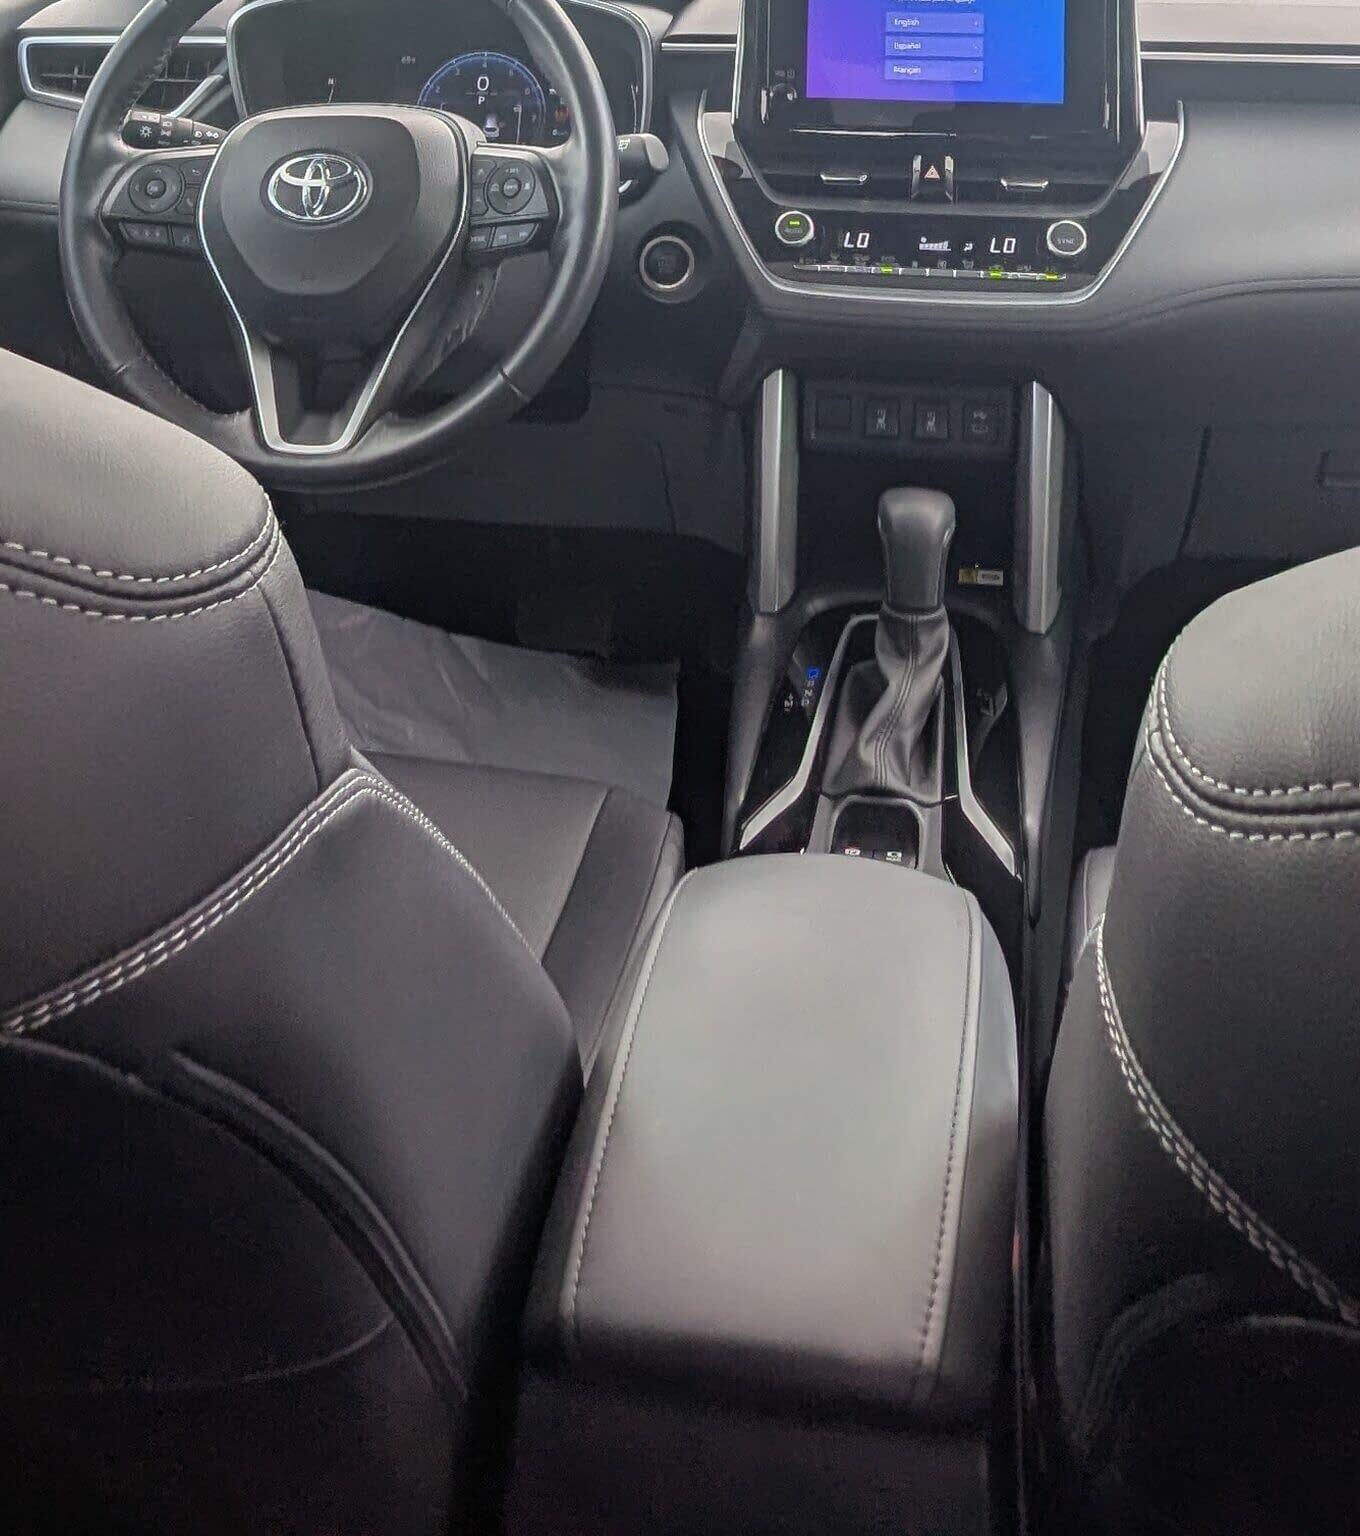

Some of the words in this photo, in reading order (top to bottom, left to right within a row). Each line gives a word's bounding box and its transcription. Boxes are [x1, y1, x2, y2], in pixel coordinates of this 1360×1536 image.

[894, 17, 920, 27] English
[894, 42, 921, 50] Español
[477, 95, 486, 105] P
